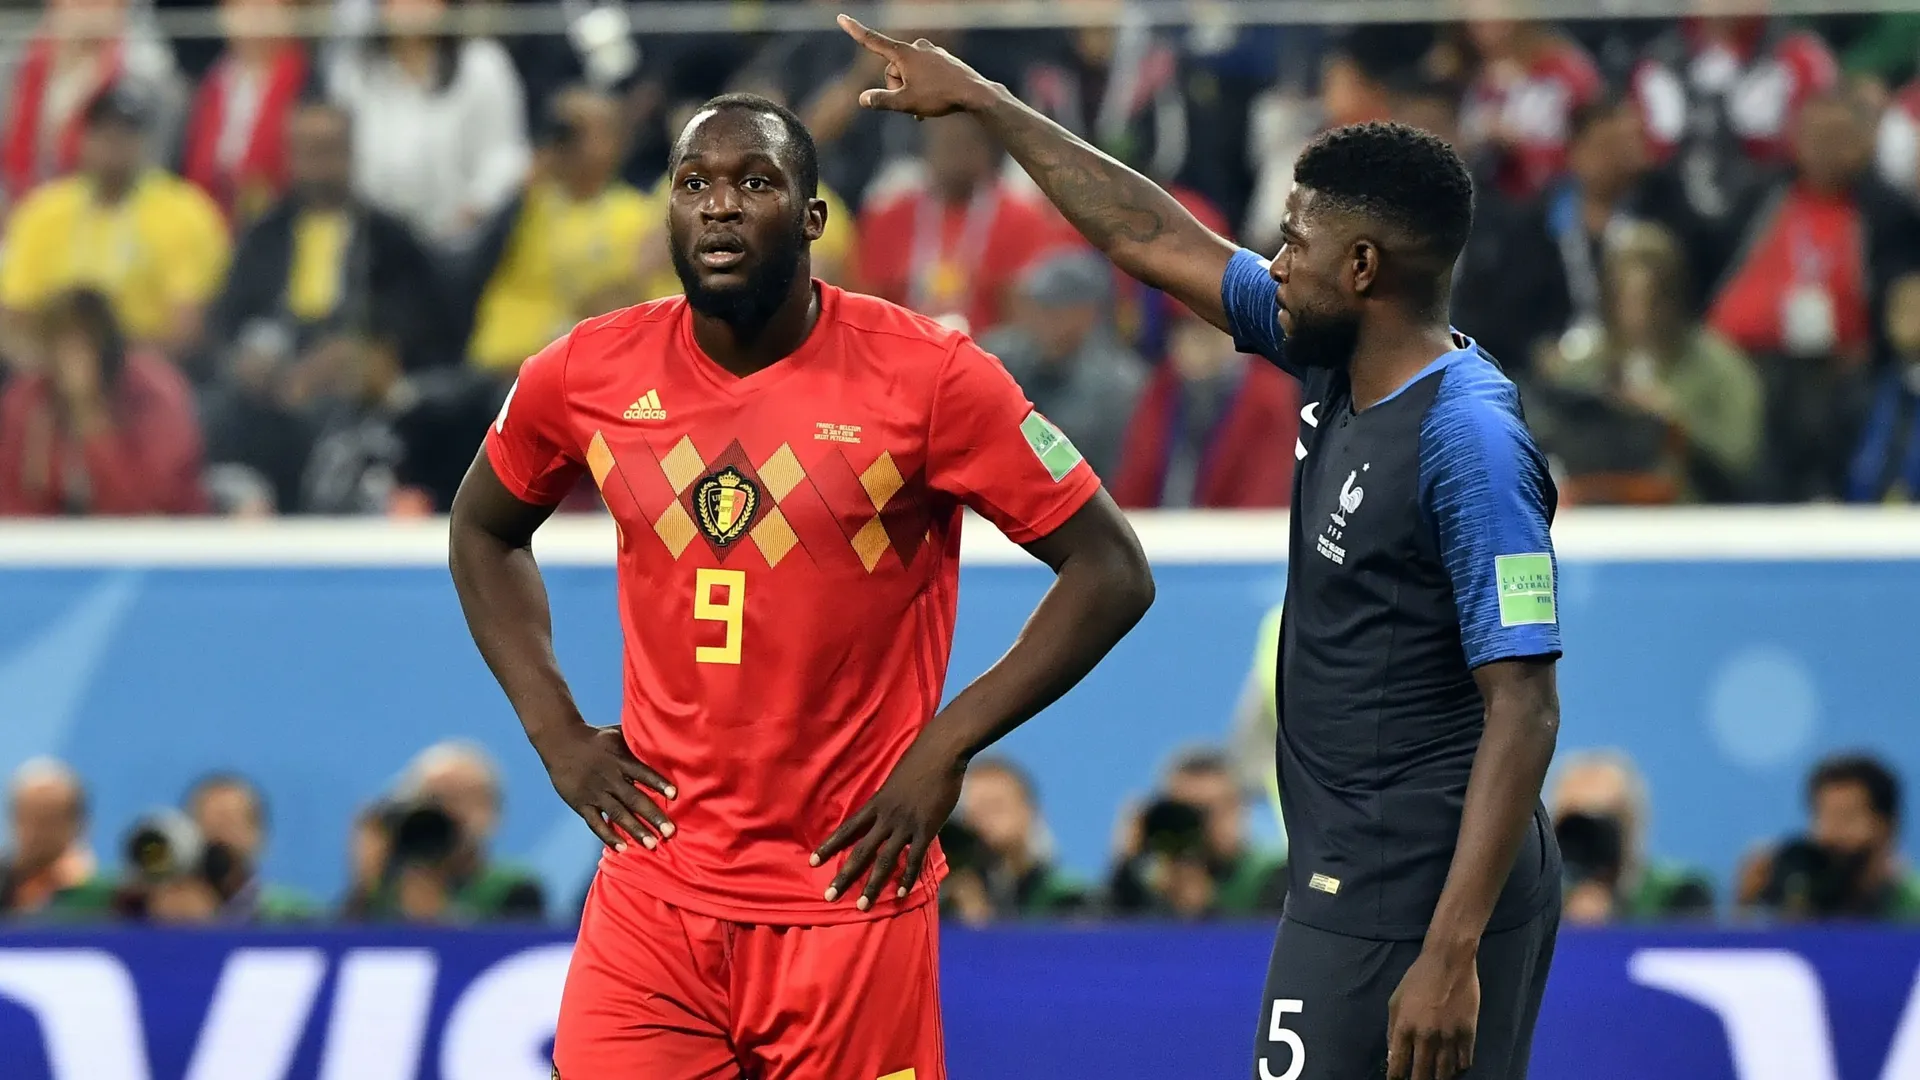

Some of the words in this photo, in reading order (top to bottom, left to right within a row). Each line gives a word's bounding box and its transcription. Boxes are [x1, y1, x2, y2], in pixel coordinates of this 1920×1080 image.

[623, 407, 666, 420] adidas
[1503, 574, 1550, 584] LIVING
[694, 568, 745, 664] 9
[1259, 999, 1306, 1080] 5
